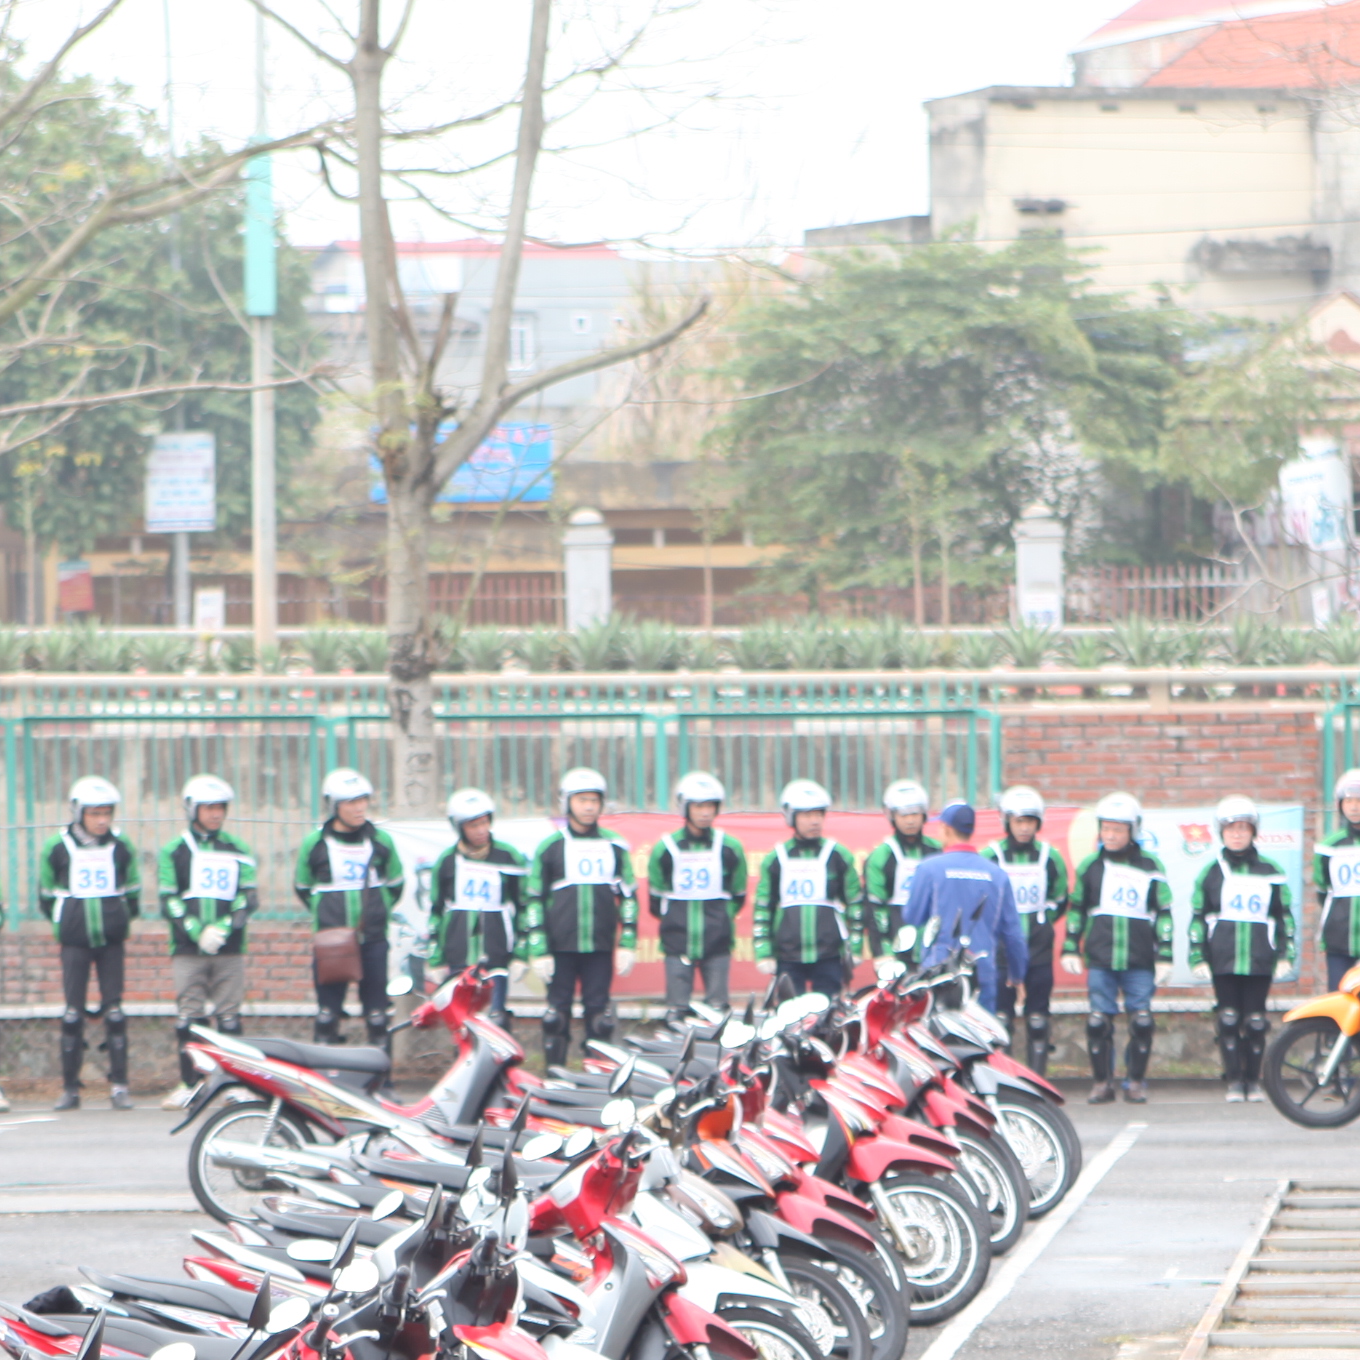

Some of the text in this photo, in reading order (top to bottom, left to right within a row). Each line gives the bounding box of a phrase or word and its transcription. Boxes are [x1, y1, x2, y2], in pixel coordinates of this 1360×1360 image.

[1252, 833, 1295, 844] NDA
[578, 858, 605, 878] 01
[78, 869, 108, 890] 35
[200, 868, 230, 890] 38
[463, 879, 491, 900] 44
[679, 868, 710, 891] 39
[786, 879, 815, 900] 40
[1016, 886, 1040, 904] 08
[1112, 886, 1139, 907] 49
[1230, 894, 1262, 914] 46
